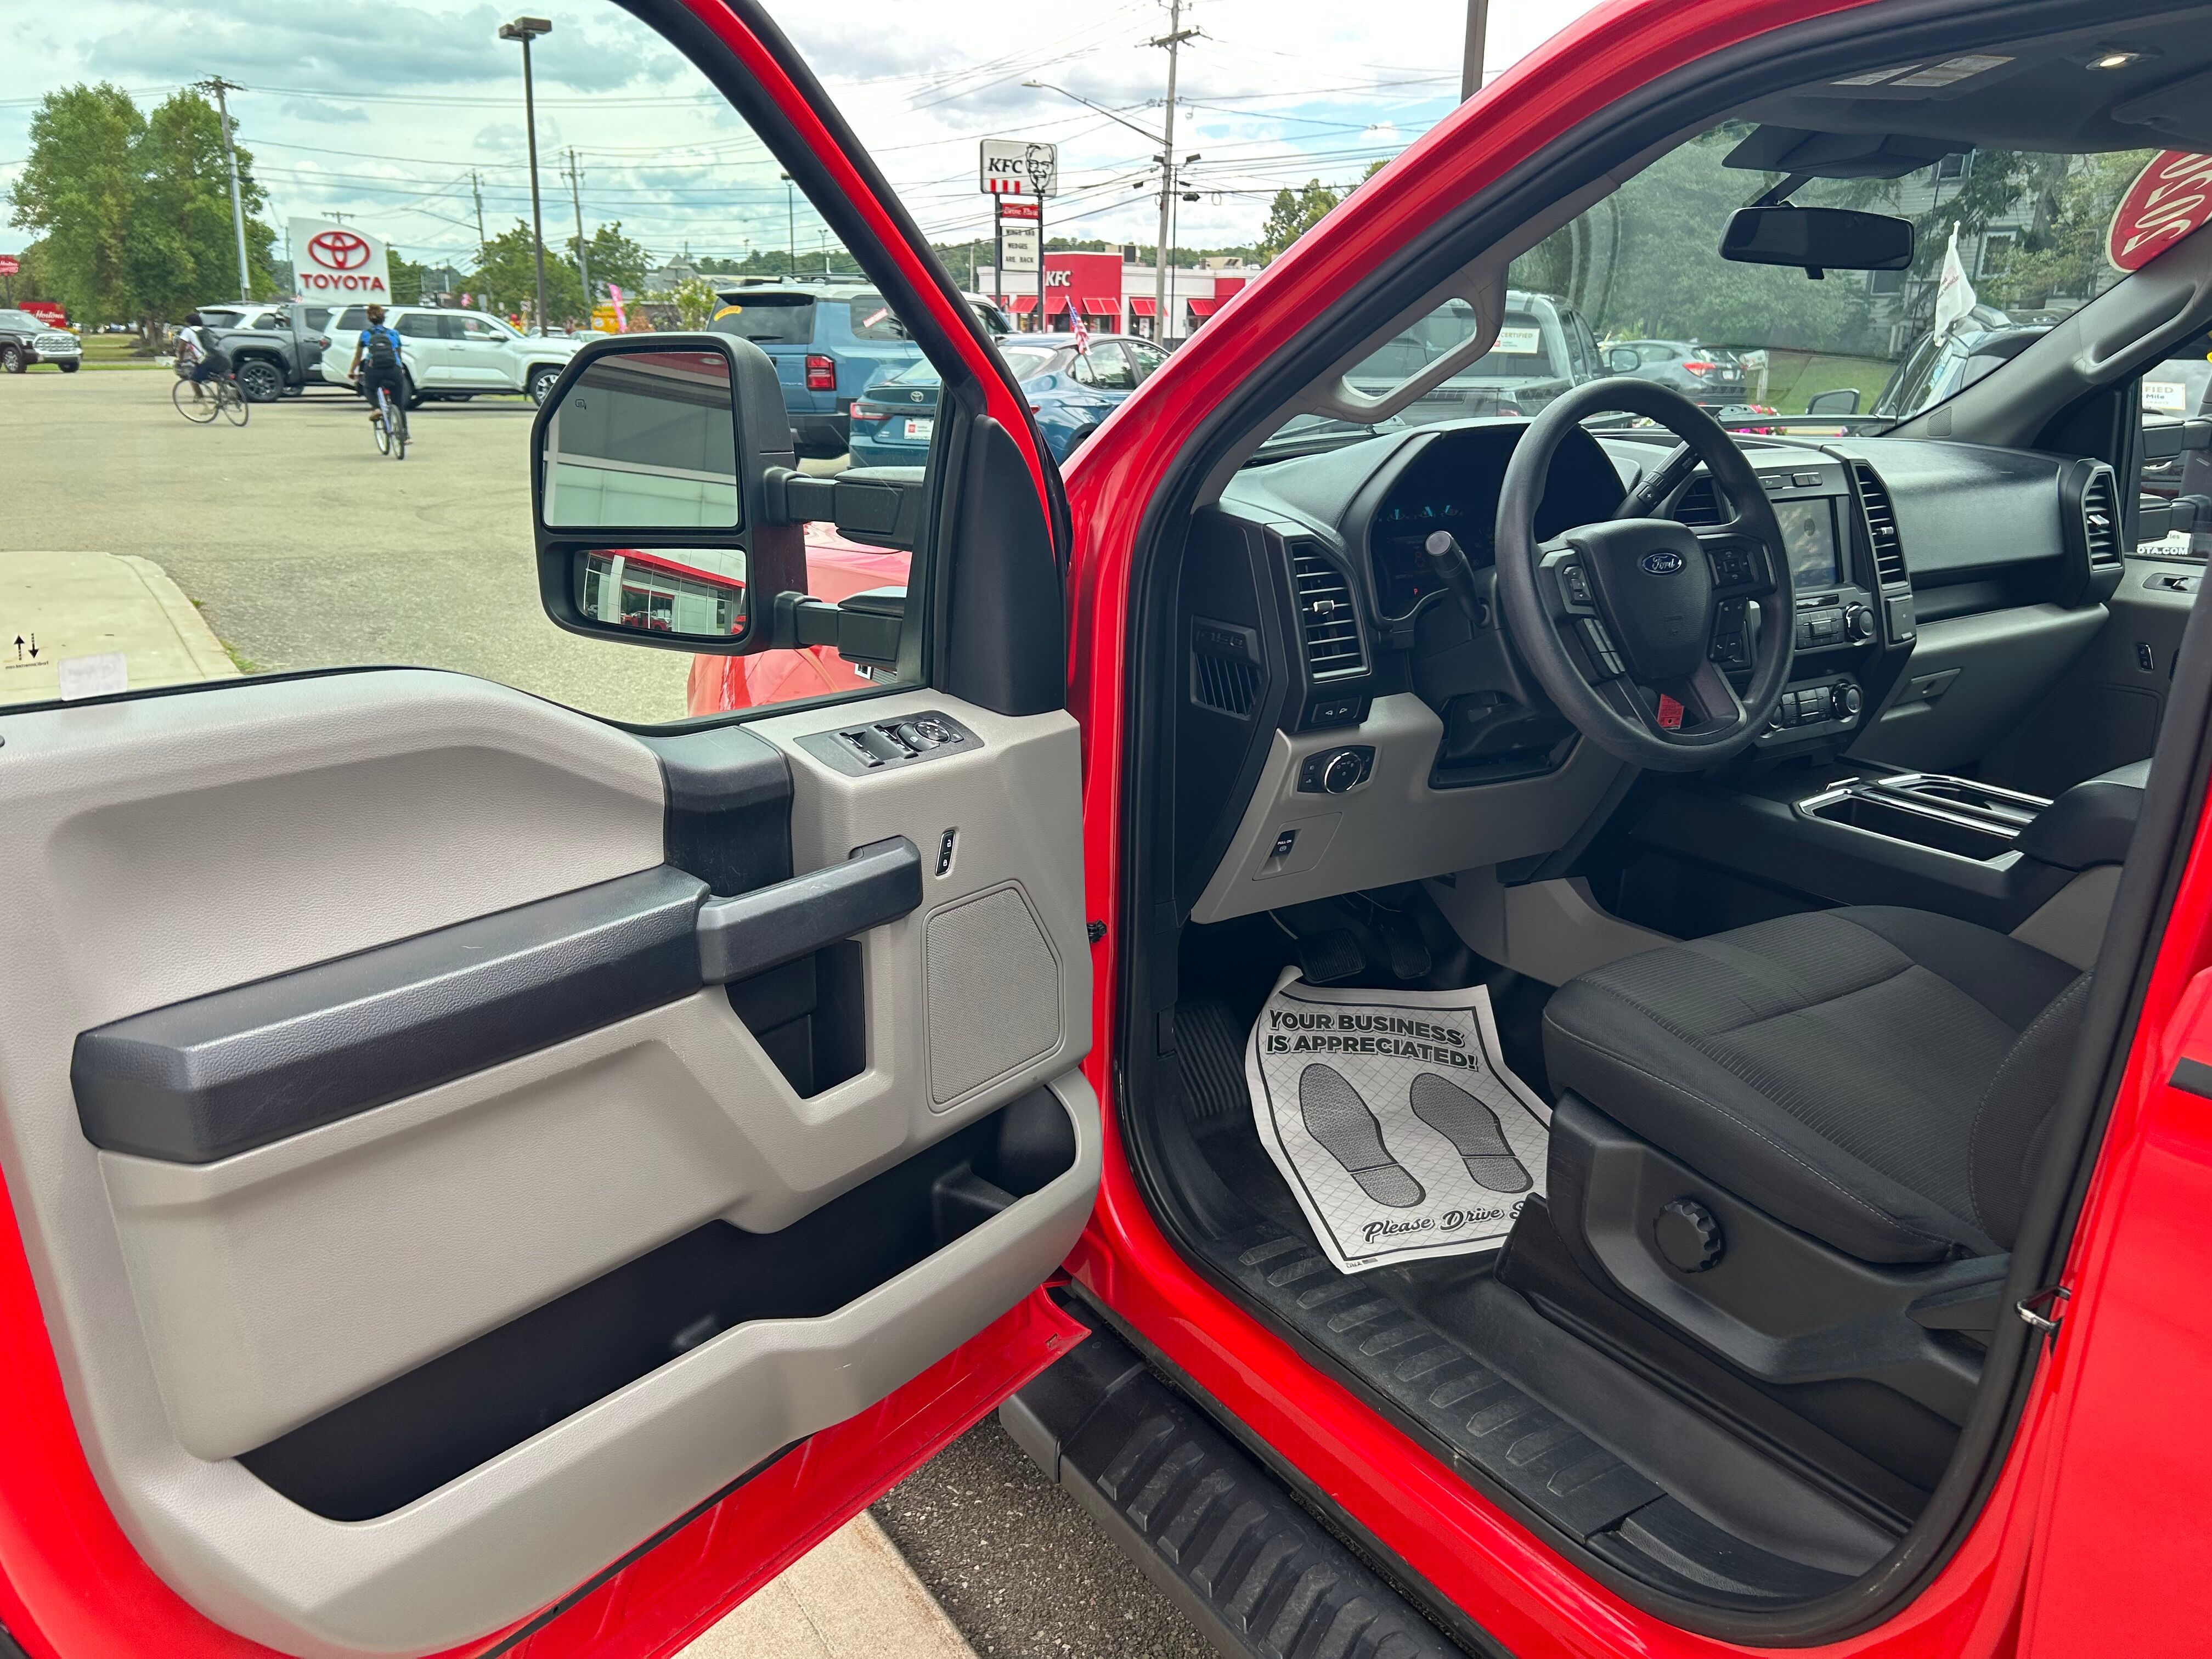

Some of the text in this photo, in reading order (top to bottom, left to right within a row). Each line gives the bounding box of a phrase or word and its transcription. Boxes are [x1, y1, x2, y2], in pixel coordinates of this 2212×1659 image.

[988, 157, 1023, 174] KFC
[299, 273, 385, 291] TOYOTA
[1045, 270, 1071, 287] KFC
[1651, 555, 1675, 571] Ford
[1269, 1009, 1465, 1048] YOUR BUSINESS
[1265, 1034, 1479, 1071] IS APPRECIATED!
[1362, 1216, 1436, 1244] Please
[1440, 1207, 1505, 1232] Drive
